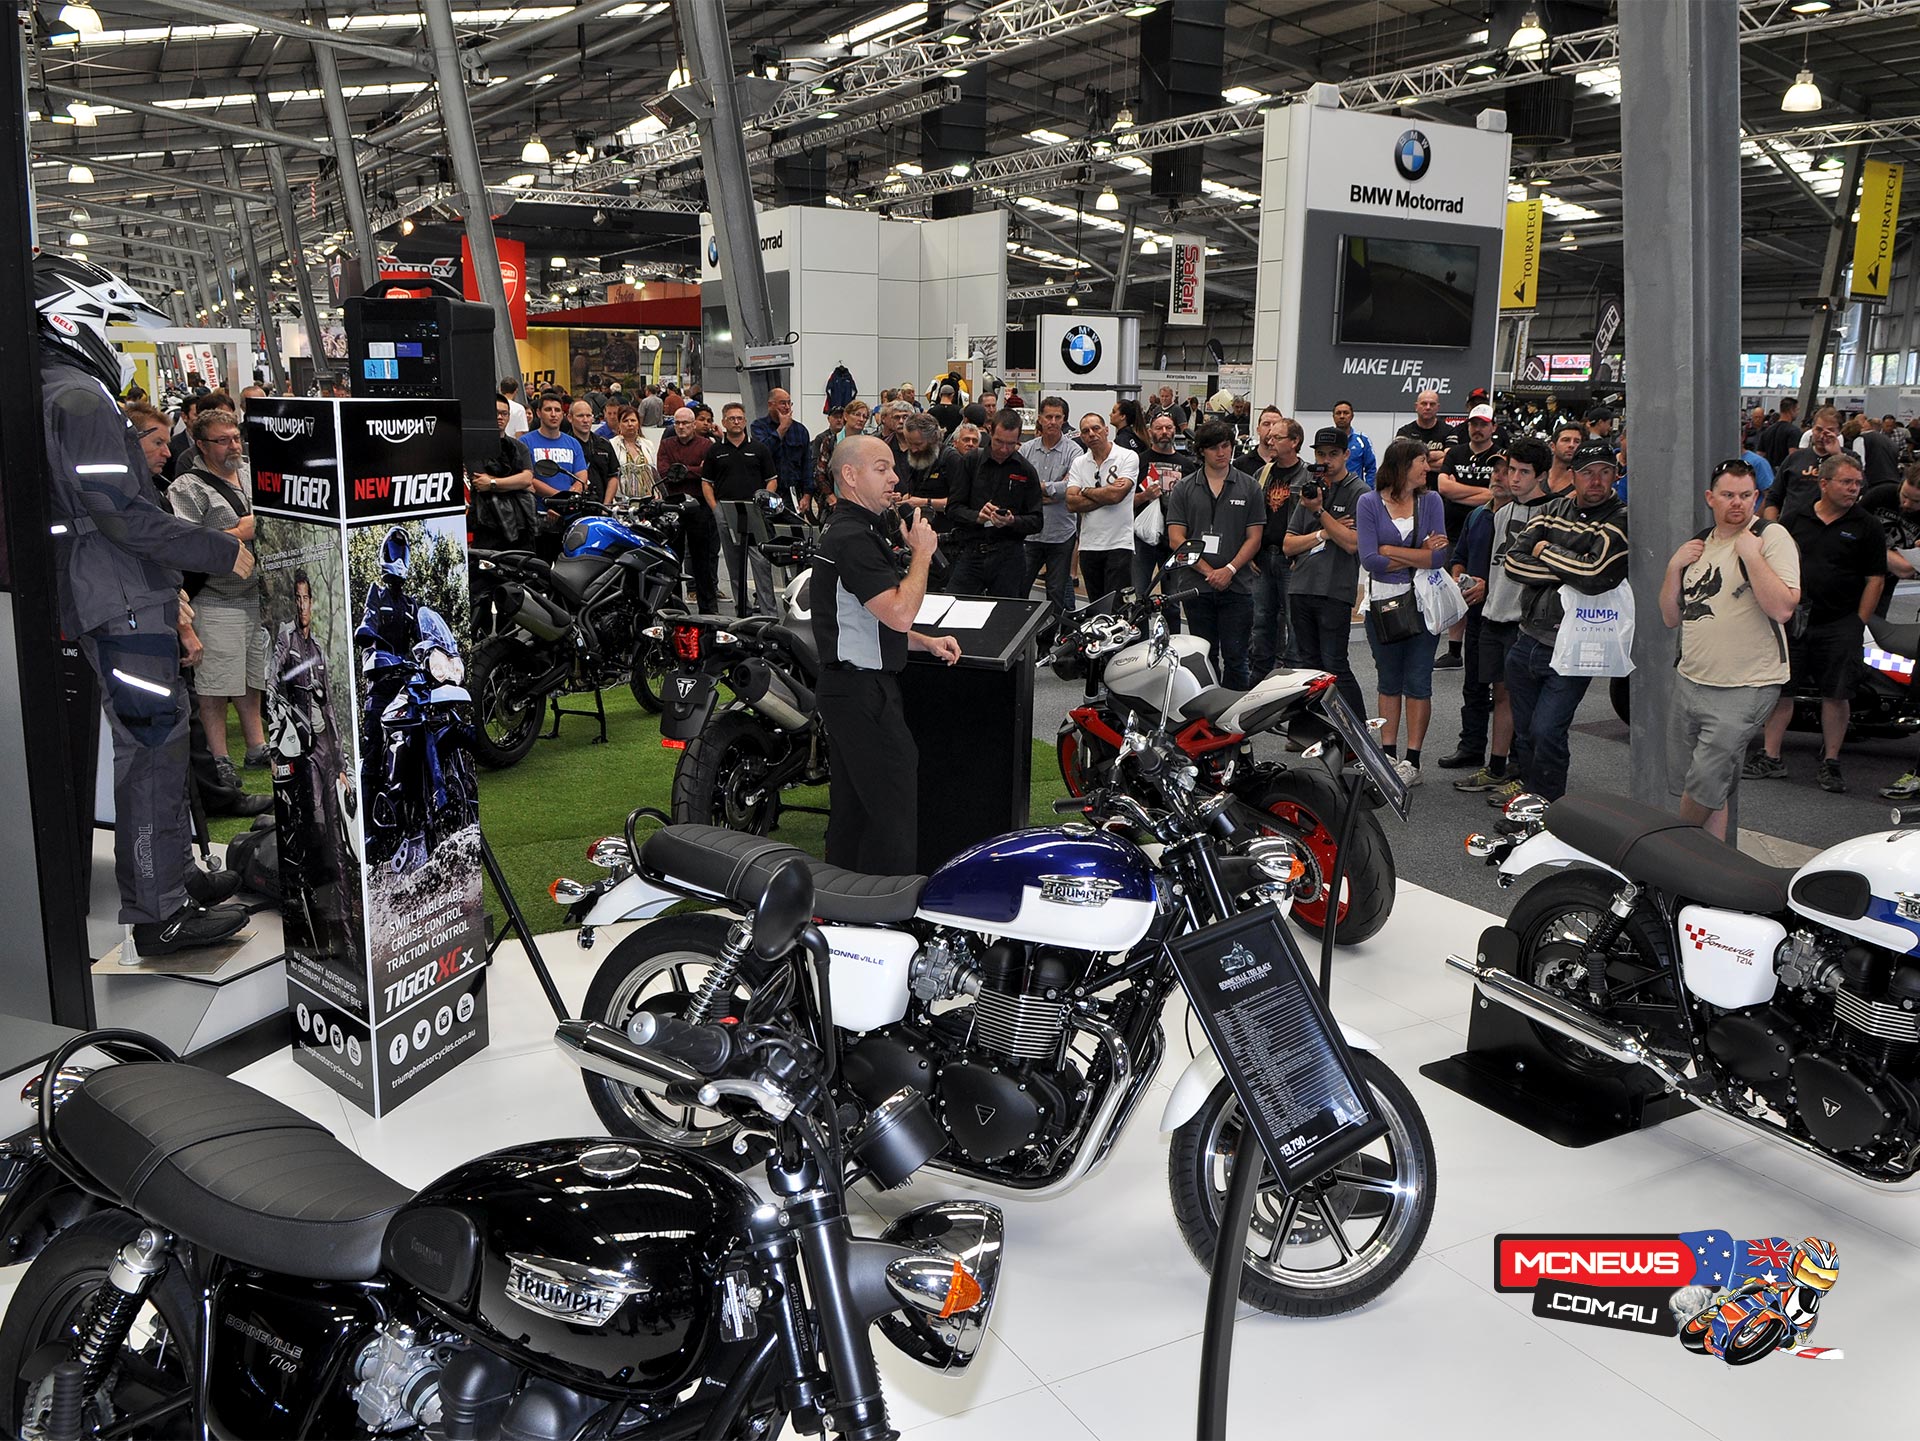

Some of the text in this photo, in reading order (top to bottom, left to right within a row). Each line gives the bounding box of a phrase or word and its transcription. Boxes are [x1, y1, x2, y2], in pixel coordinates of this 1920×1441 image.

[1350, 184, 1464, 214] BMW Motorrad
[1878, 167, 1898, 262] TOURATECH
[760, 229, 783, 251] orrad
[1523, 202, 1537, 280] TOURATECH
[378, 263, 454, 277] VICTORY
[1182, 244, 1200, 315] Safari
[52, 315, 74, 333] BELL
[1342, 357, 1424, 376] MAKE LIFE
[1401, 377, 1452, 394] A RIDE.
[263, 416, 306, 442] TRIUMPH
[366, 418, 424, 443] TRIUMPH
[257, 471, 331, 510] NEW TIGER
[354, 472, 454, 507] NEW TIGER
[1575, 608, 1619, 624] RIUMPH
[134, 823, 153, 879] TRIUMPH
[1049, 884, 1102, 903] TRIUMPH
[389, 887, 464, 935] SWITCHABLE ABS
[391, 906, 464, 952] CRUISE CONTROL
[386, 920, 470, 974] TRACTION CONTROL
[829, 948, 885, 966] BONNEVILLE
[1699, 933, 1755, 958] Bonneville
[293, 950, 301, 960] NO
[300, 954, 324, 975] ORDINARY
[1736, 955, 1753, 966] T214
[290, 960, 363, 1011] NO ORDINARY ADVENTURE BIKE
[1218, 971, 1247, 990] BONNEVILLE
[1257, 961, 1273, 974] BLACK
[391, 1029, 476, 1089] triumphmotorcycles.com.au
[516, 1269, 601, 1314] TRIUMPH
[225, 1313, 304, 1359] BONNEVILLE
[268, 1353, 297, 1374] T100
